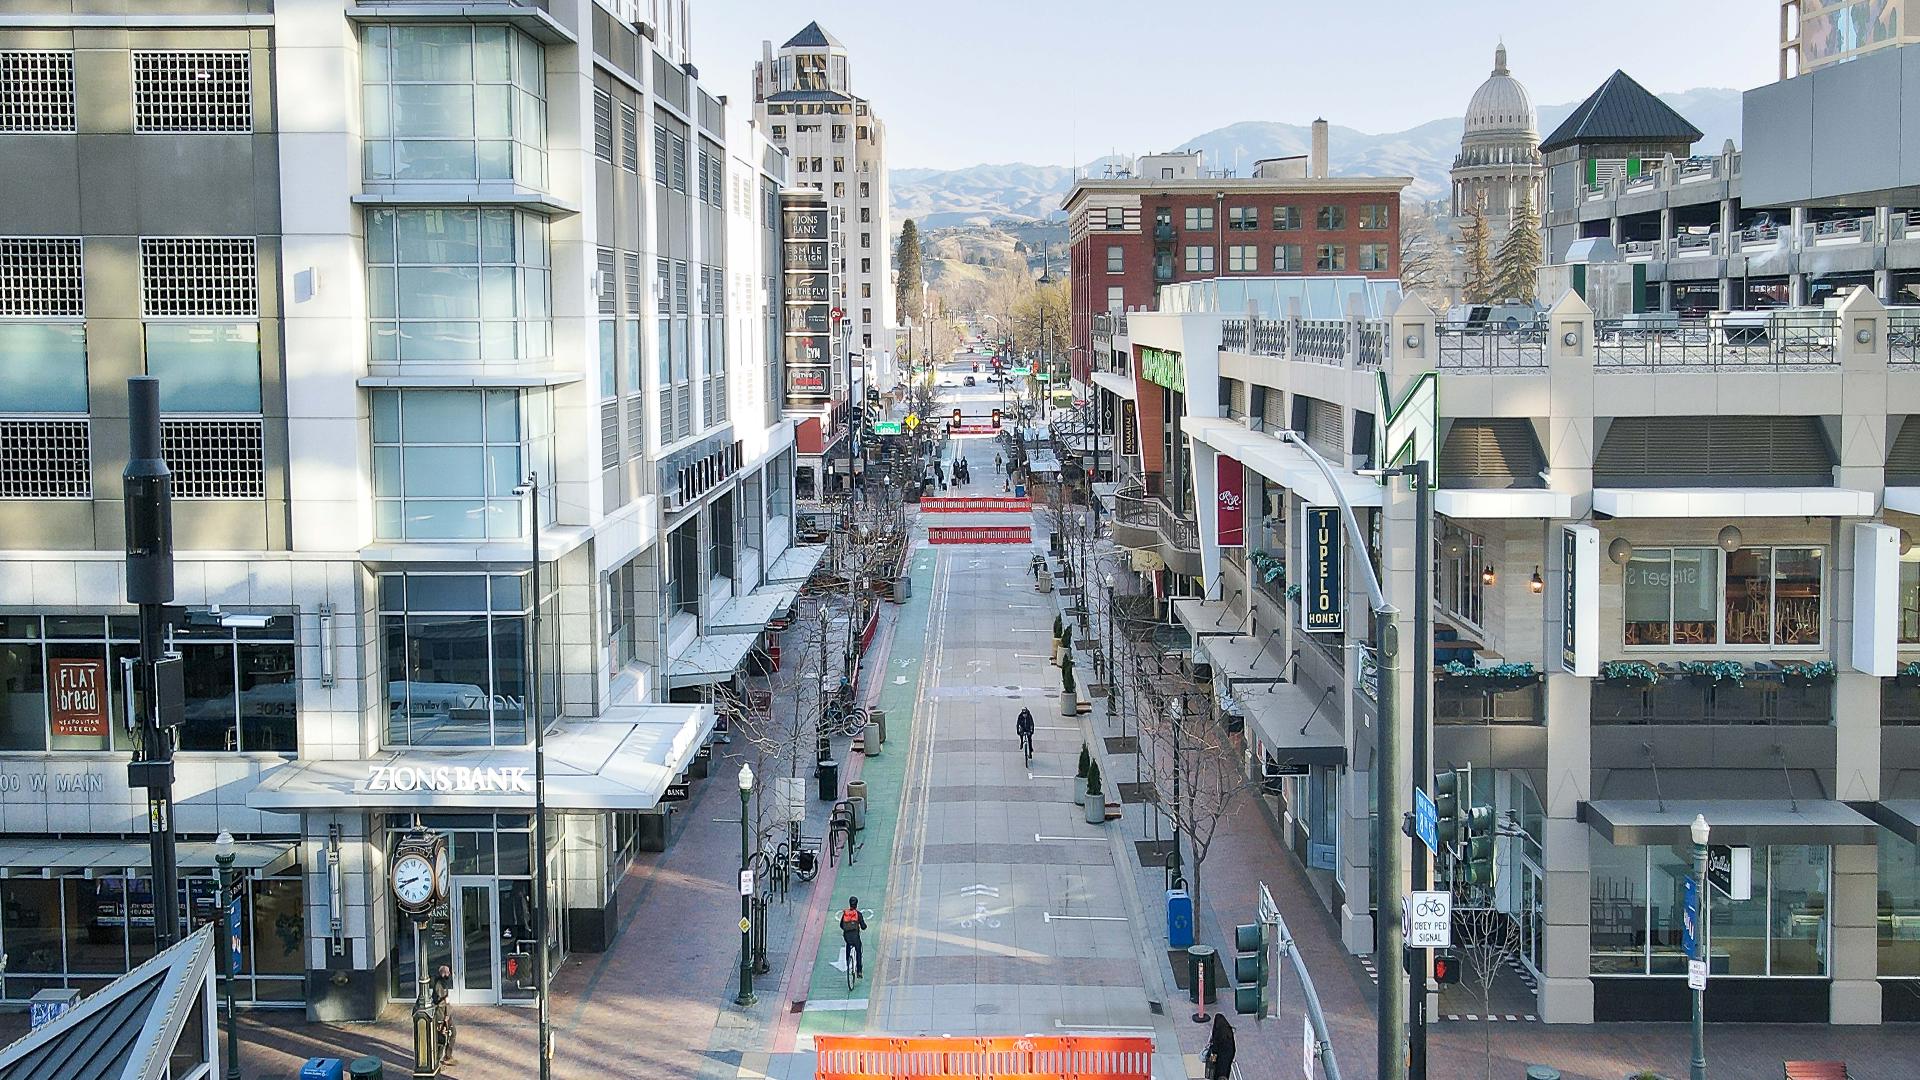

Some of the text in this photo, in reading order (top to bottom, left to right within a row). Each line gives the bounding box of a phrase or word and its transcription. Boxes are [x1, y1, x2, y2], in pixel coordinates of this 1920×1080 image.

[792, 216, 818, 224] ZIONS
[793, 226, 817, 234] BANK
[793, 246, 822, 255] SMILE
[798, 287, 811, 296] THE
[812, 287, 825, 296] FLY
[806, 347, 821, 359] GYM
[1318, 511, 1329, 611] TUPELO
[1308, 613, 1340, 624] HONEY
[61, 668, 96, 688] FLAT
[60, 689, 96, 711] bread
[28, 774, 48, 793] W
[55, 773, 104, 793] MAIN
[367, 765, 532, 792] ZIONS BANK
[667, 788, 685, 797] BANK
[1414, 921, 1447, 931] OBEY PED
[1418, 932, 1442, 942] SIGNAL
